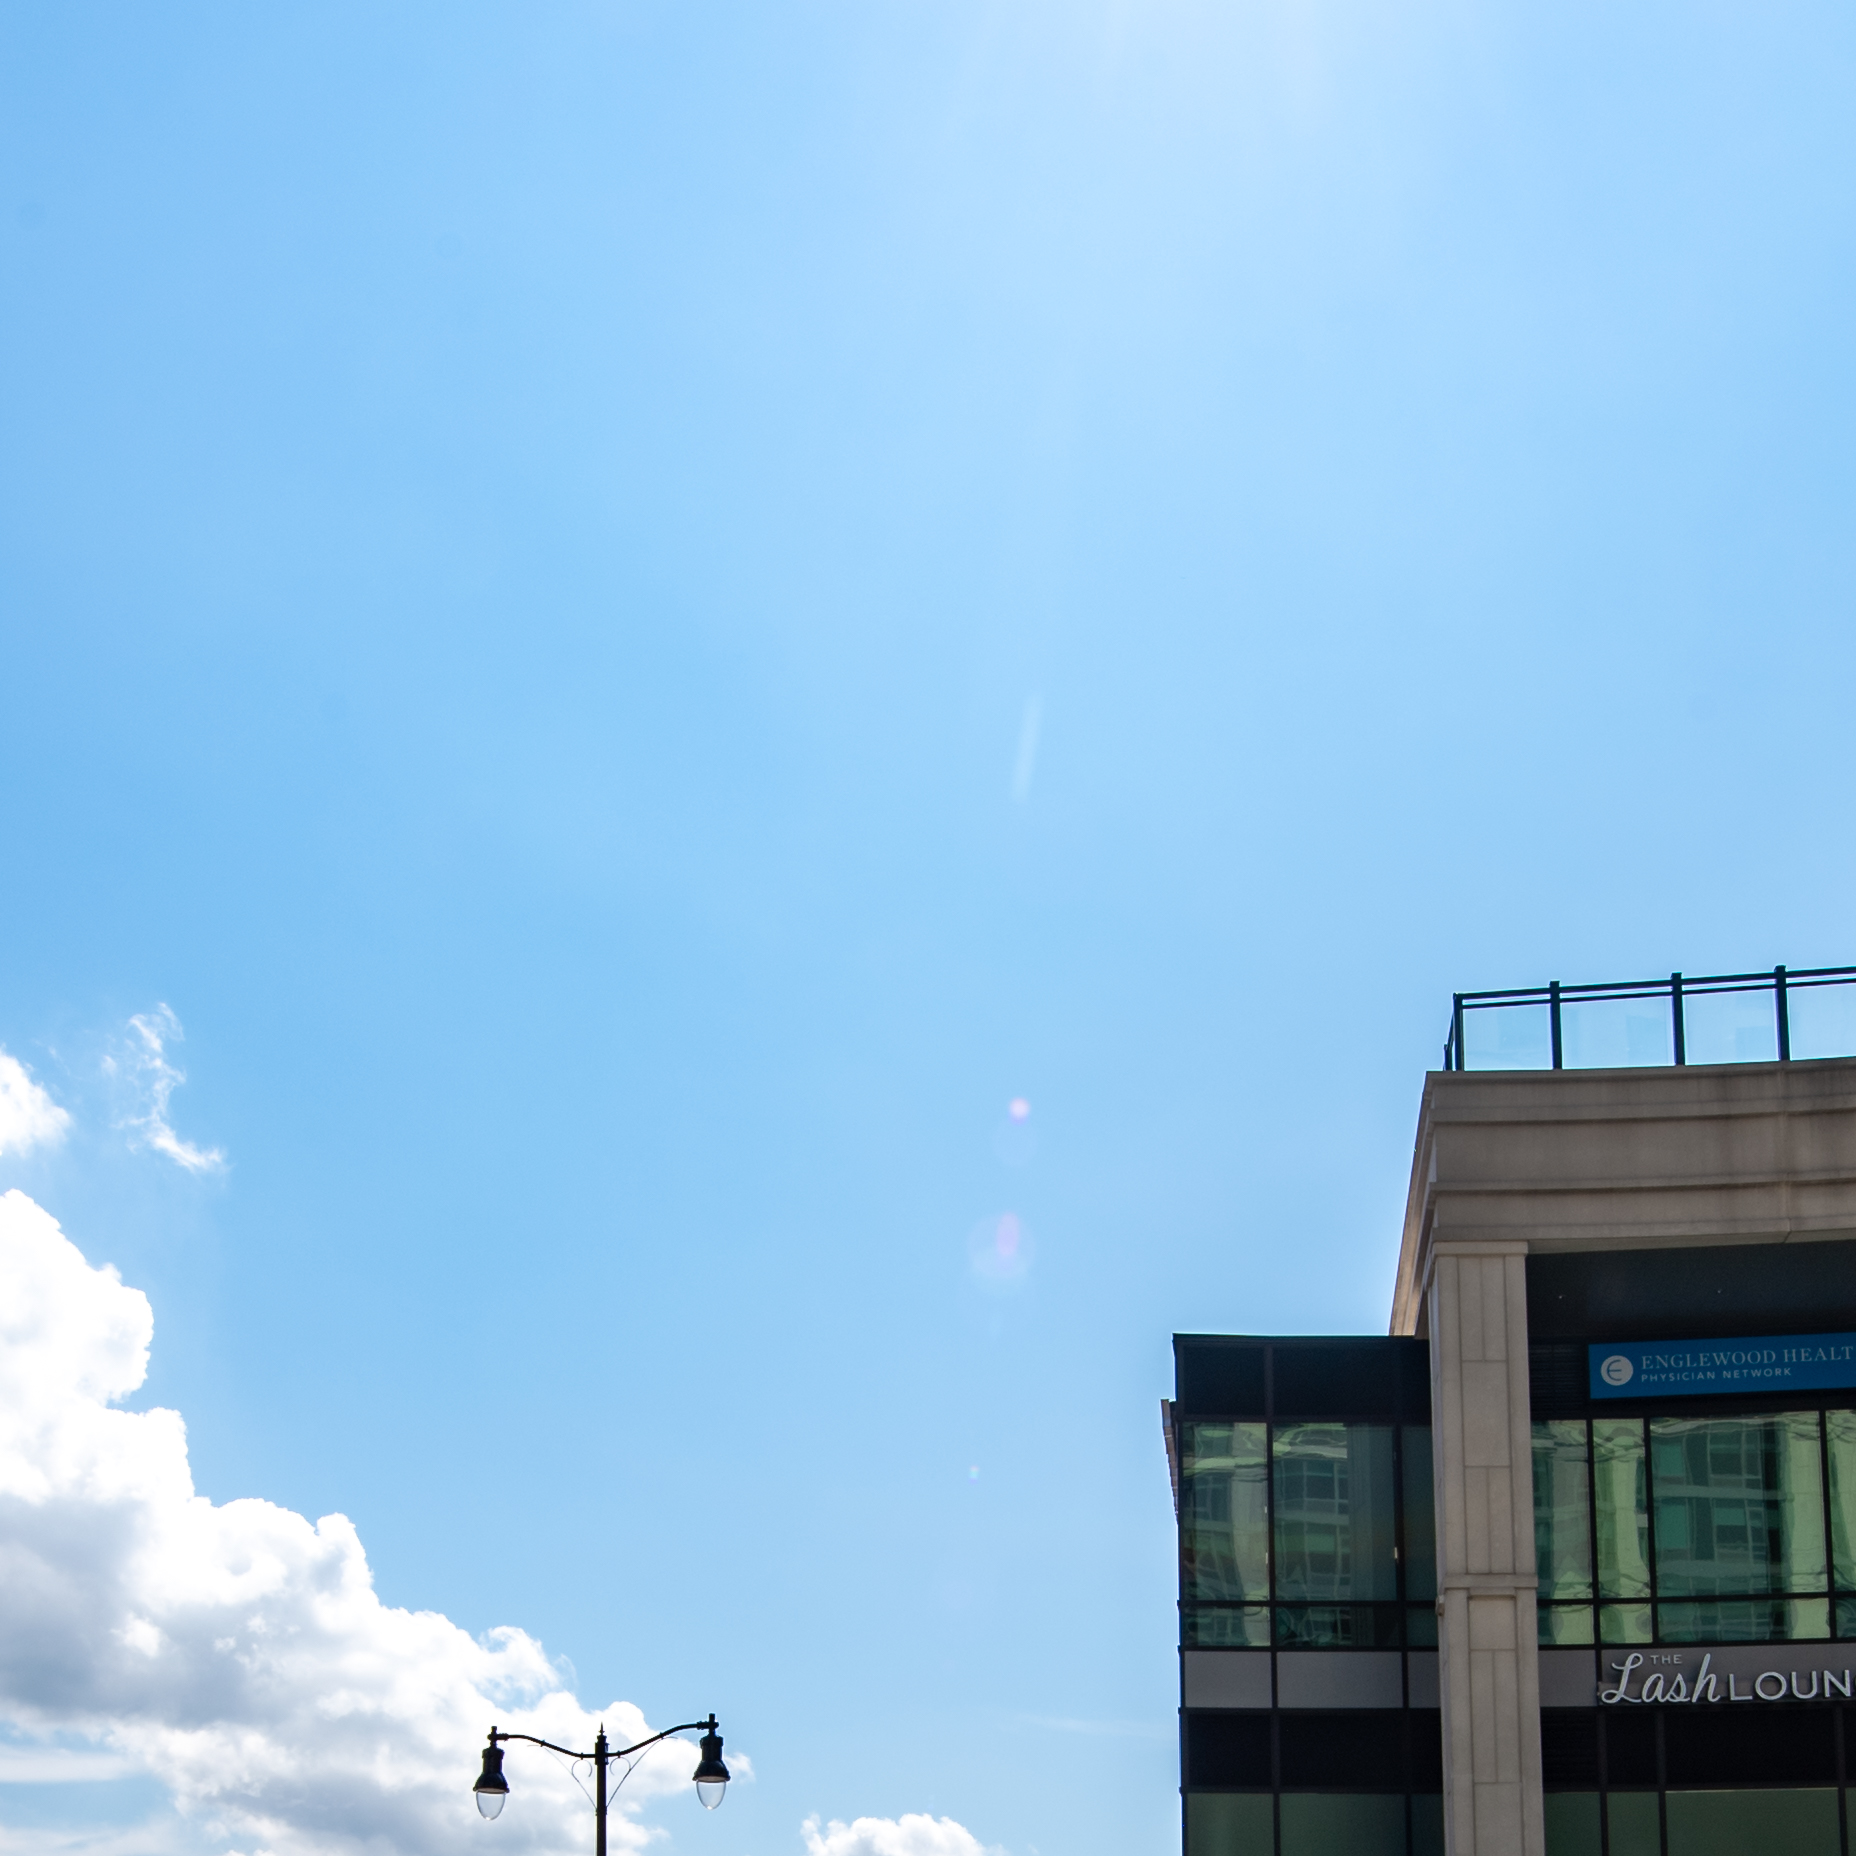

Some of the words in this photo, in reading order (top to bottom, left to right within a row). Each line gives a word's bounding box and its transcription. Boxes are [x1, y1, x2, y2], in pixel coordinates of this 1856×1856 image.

[1641, 1349, 1776, 1370] ENGLEWOOD
[1641, 1371, 1716, 1383] PHYSICIAN
[1722, 1367, 1792, 1380] NETWORK
[1650, 1654, 1683, 1665] THE
[1600, 1652, 1721, 1704] Lash
